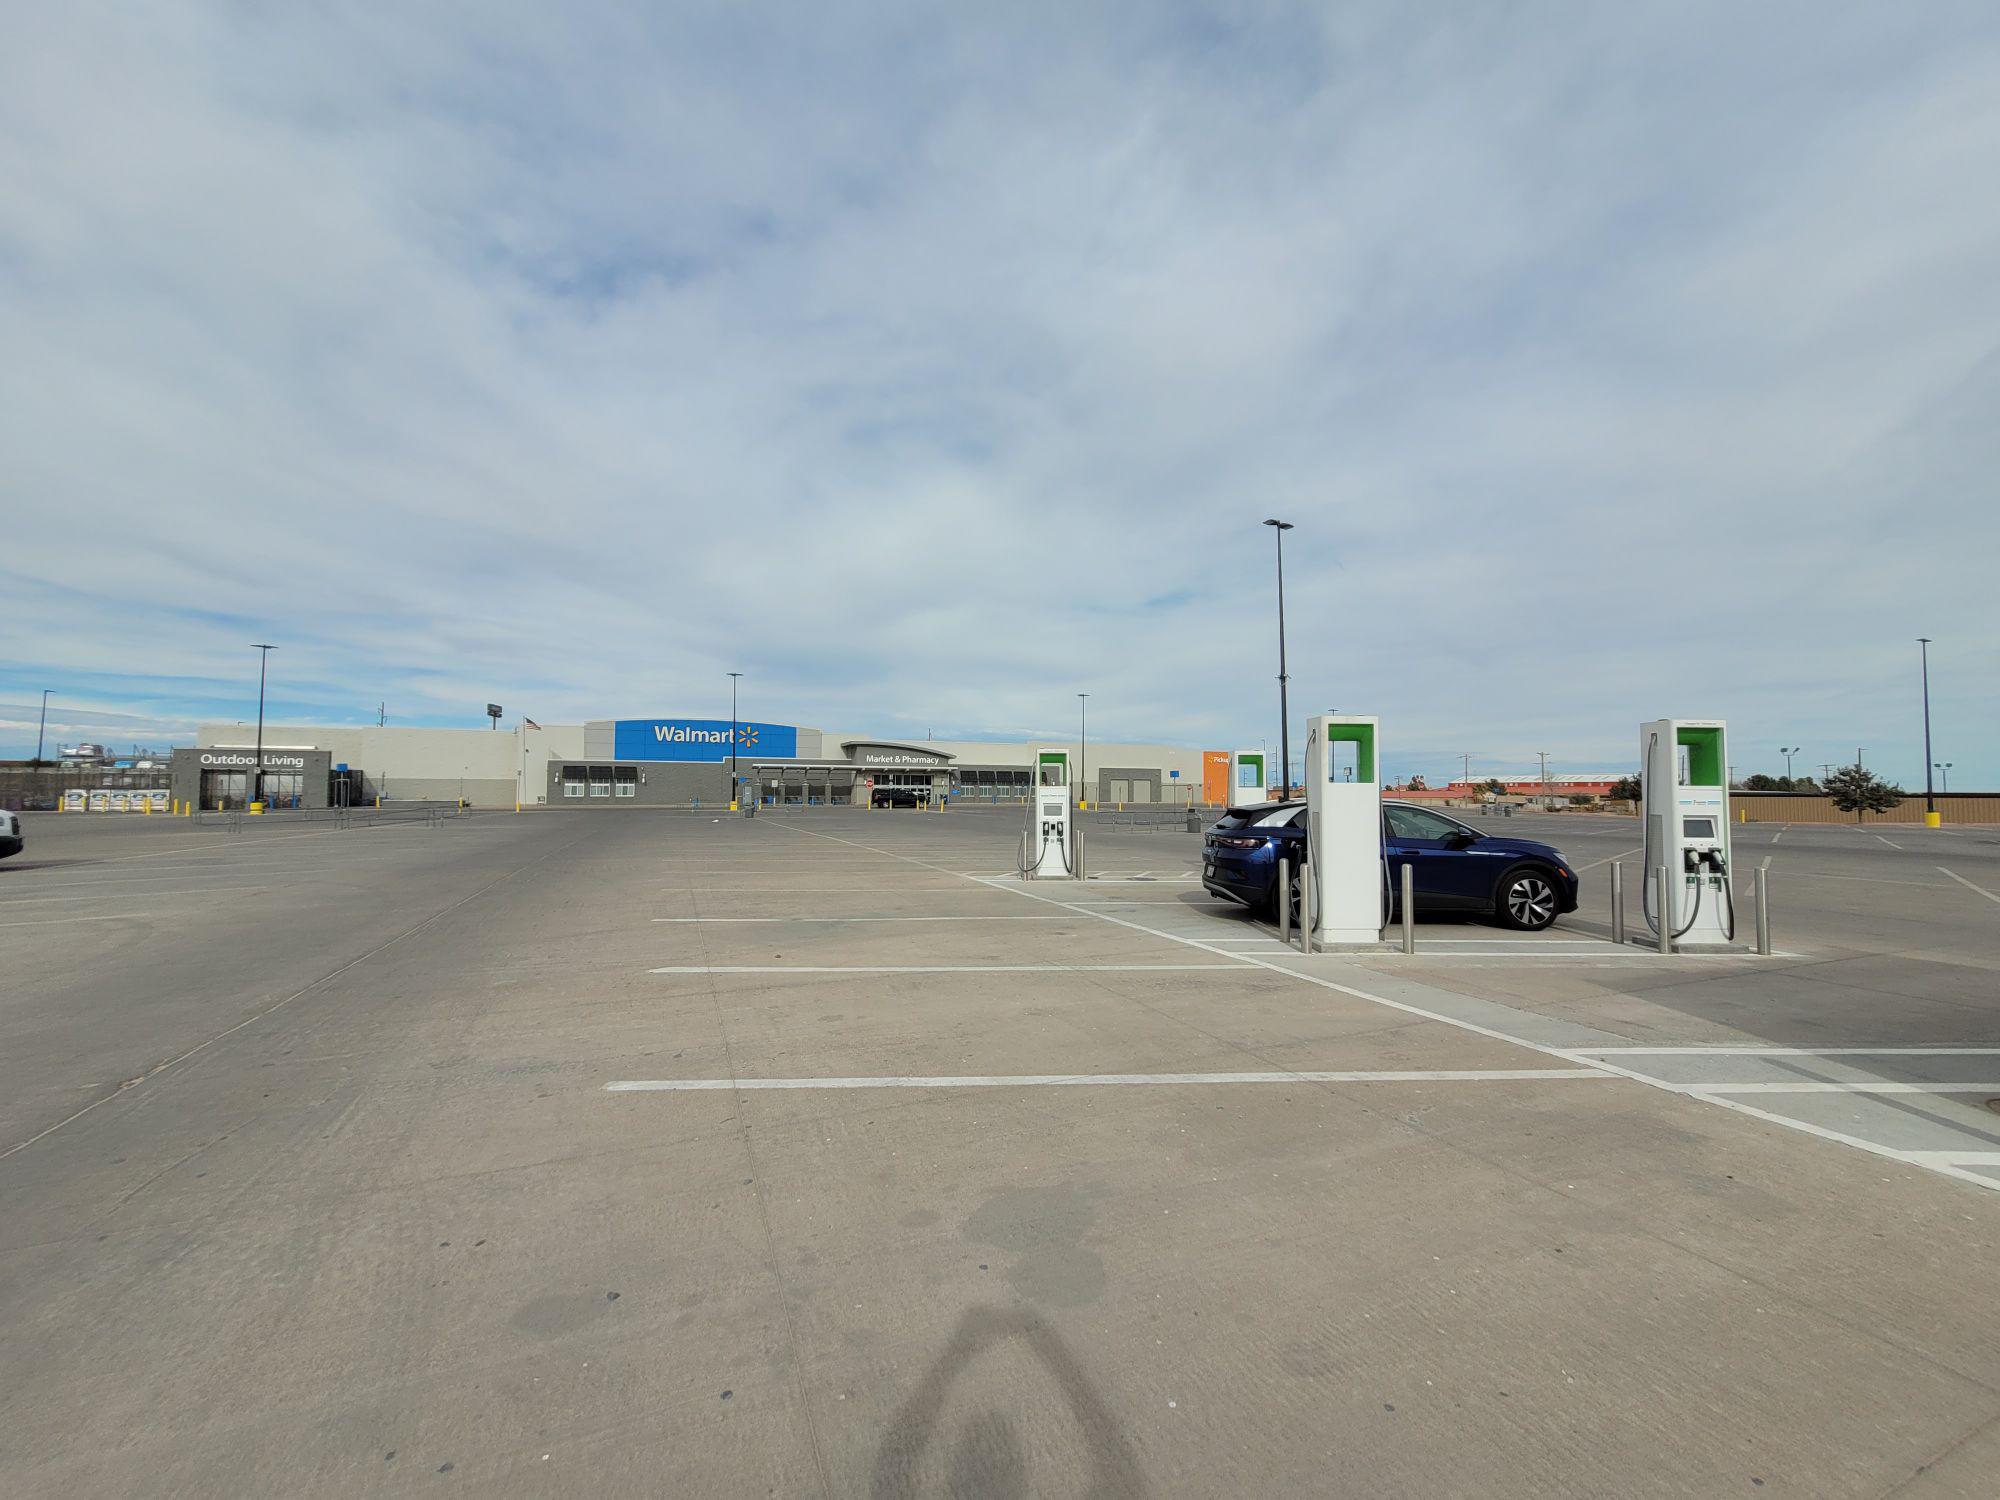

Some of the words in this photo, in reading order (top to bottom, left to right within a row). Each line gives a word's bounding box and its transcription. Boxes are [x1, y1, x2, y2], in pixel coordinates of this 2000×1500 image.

[654, 725, 735, 744] Walmart
[263, 755, 304, 768] Living
[866, 754, 894, 763] Market
[894, 755, 901, 763] &
[902, 755, 940, 766] Pharmacy
